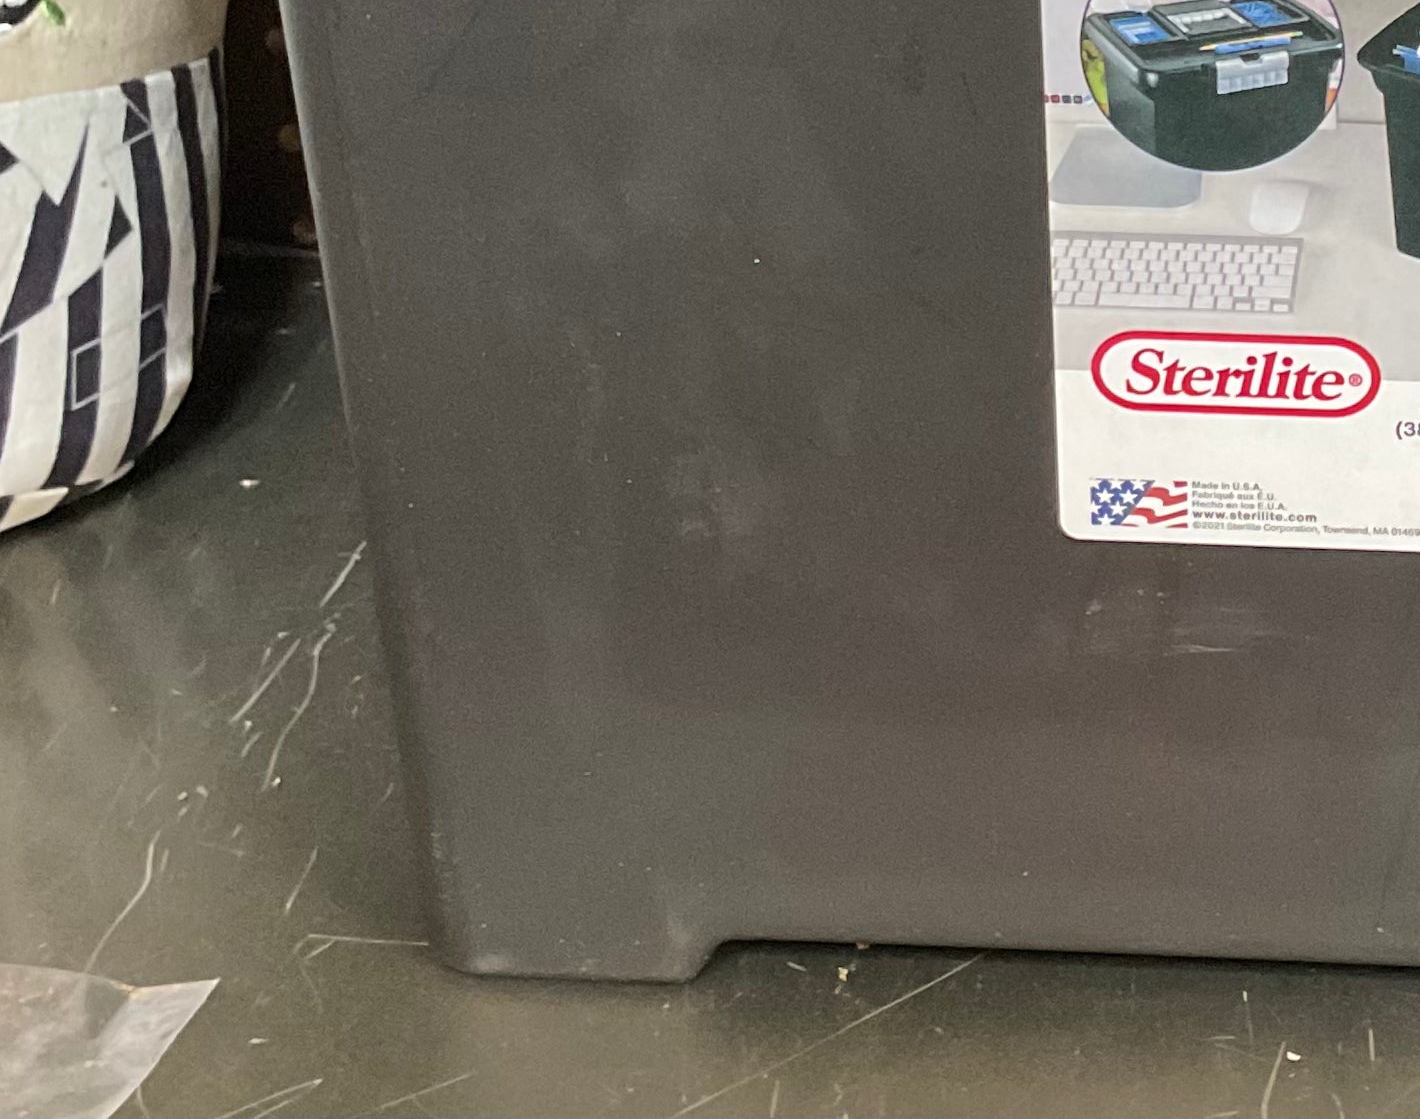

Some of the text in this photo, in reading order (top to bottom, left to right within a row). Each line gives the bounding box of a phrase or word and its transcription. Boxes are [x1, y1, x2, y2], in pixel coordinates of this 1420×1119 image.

[1192, 481, 1219, 490] Made
[1221, 482, 1230, 490] in
[1192, 501, 1223, 509] Hecho
[1240, 501, 1255, 510] los
[1192, 510, 1317, 523] www.sterilite.com
